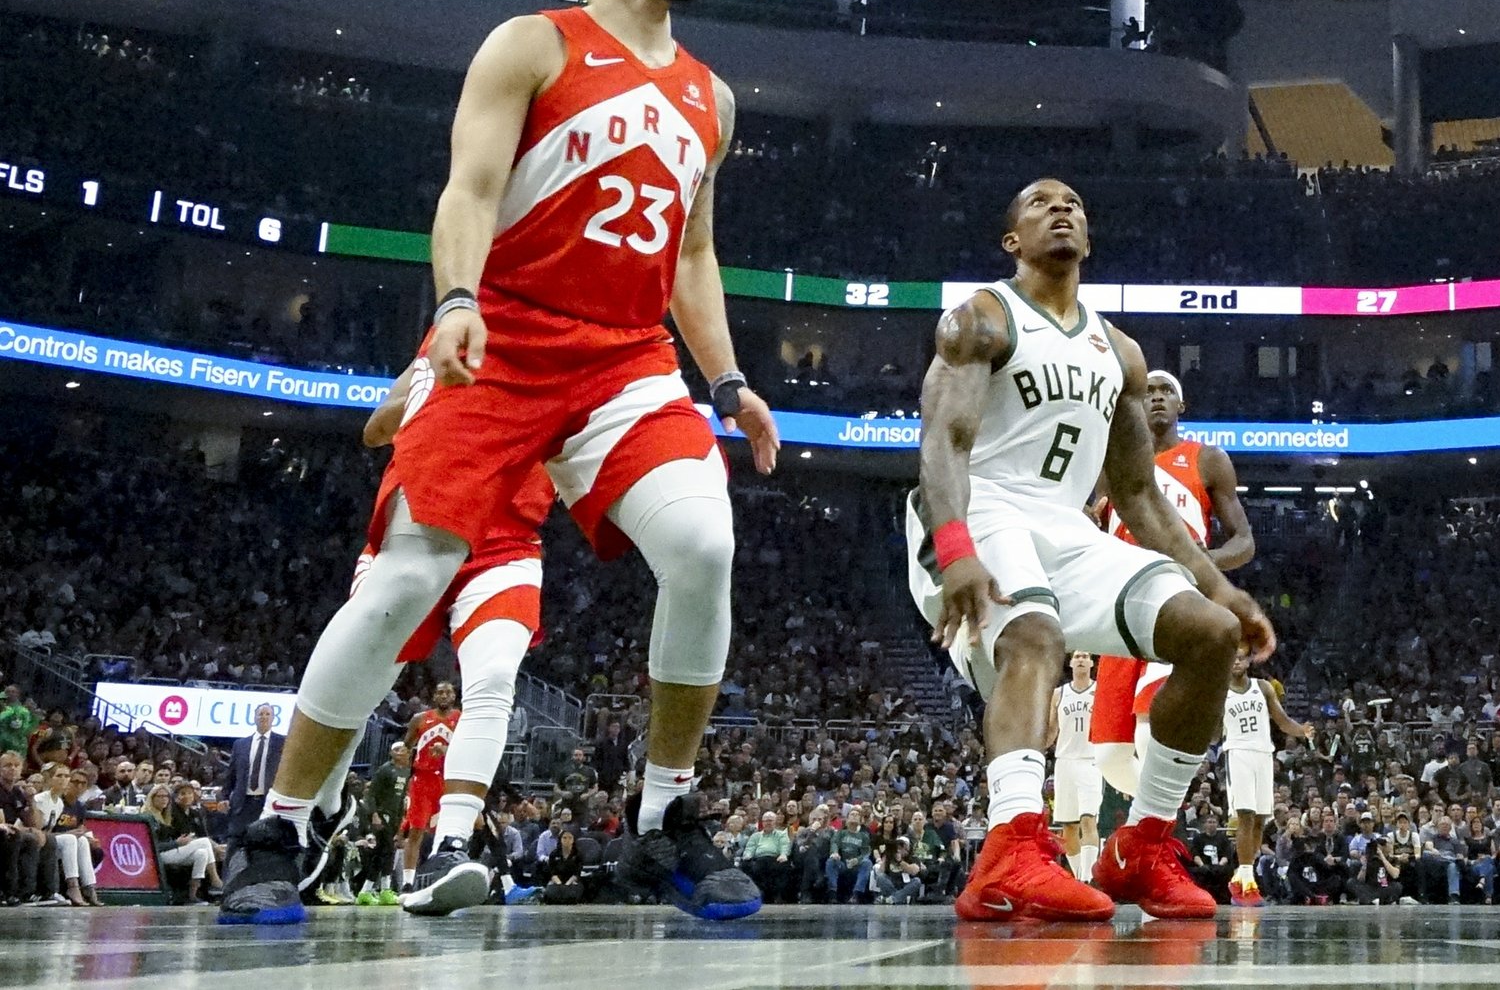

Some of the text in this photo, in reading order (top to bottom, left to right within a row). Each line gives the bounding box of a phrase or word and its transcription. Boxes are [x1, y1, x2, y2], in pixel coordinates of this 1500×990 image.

[82, 180, 99, 206] 1
[176, 199, 282, 243] TOL 6
[584, 174, 676, 255] 23
[845, 283, 890, 307] 32
[1179, 289, 1239, 310] 2nd
[1356, 290, 1398, 313] 27
[0, 326, 98, 365] Controls
[105, 350, 183, 378] makes
[190, 359, 261, 389] Fiserv
[266, 370, 340, 401] Forum
[1013, 362, 1120, 424] BUCKS
[1242, 427, 1349, 448] connected
[1039, 422, 1082, 482] 6
[112, 703, 152, 716] BMO
[1228, 699, 1264, 718] BUCKS
[1074, 716, 1084, 732] 11
[1239, 716, 1258, 733] 22
[115, 843, 142, 866] KIA
